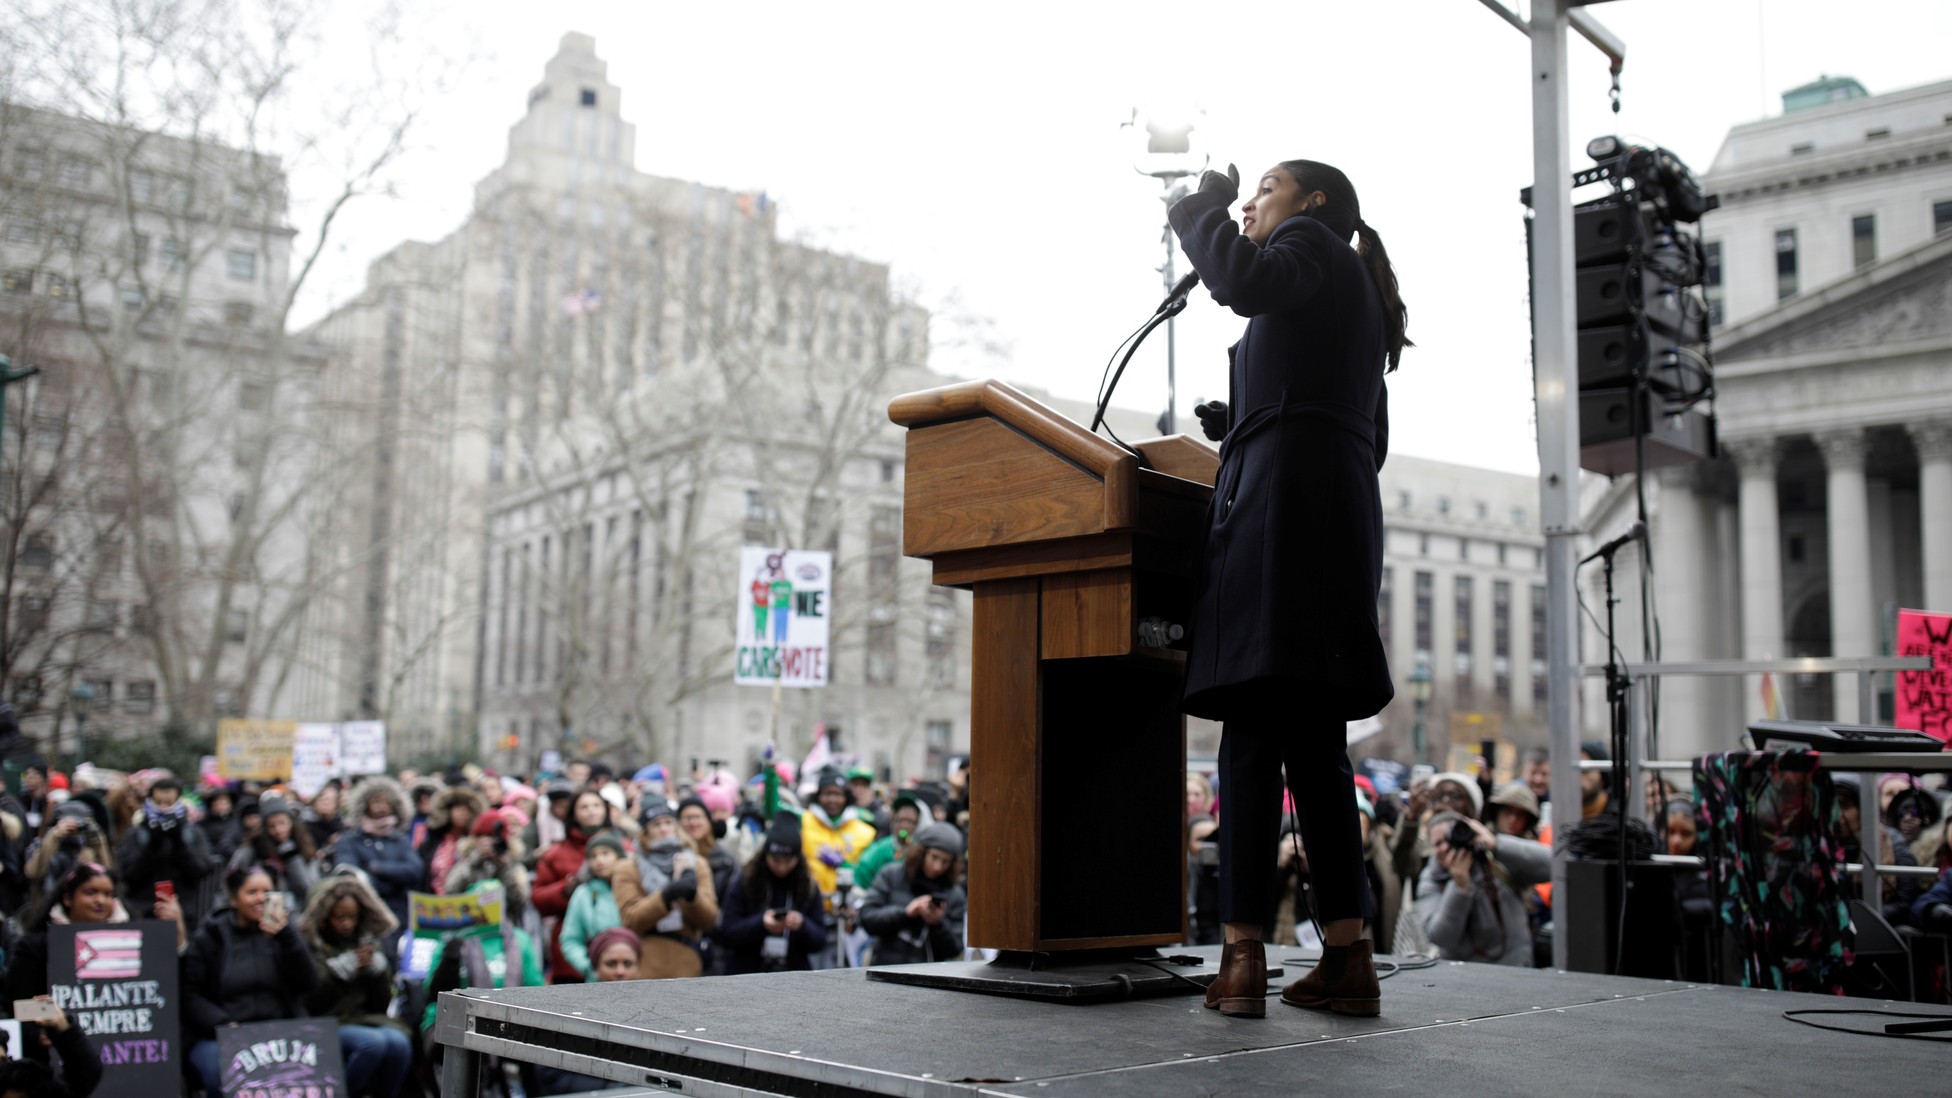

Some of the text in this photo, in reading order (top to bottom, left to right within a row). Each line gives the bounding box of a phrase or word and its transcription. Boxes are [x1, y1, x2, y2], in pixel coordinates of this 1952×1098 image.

[77, 1008, 153, 1036] EMPRE
[101, 1040, 169, 1065] ANTE!
[239, 1039, 318, 1073] BRUJA
